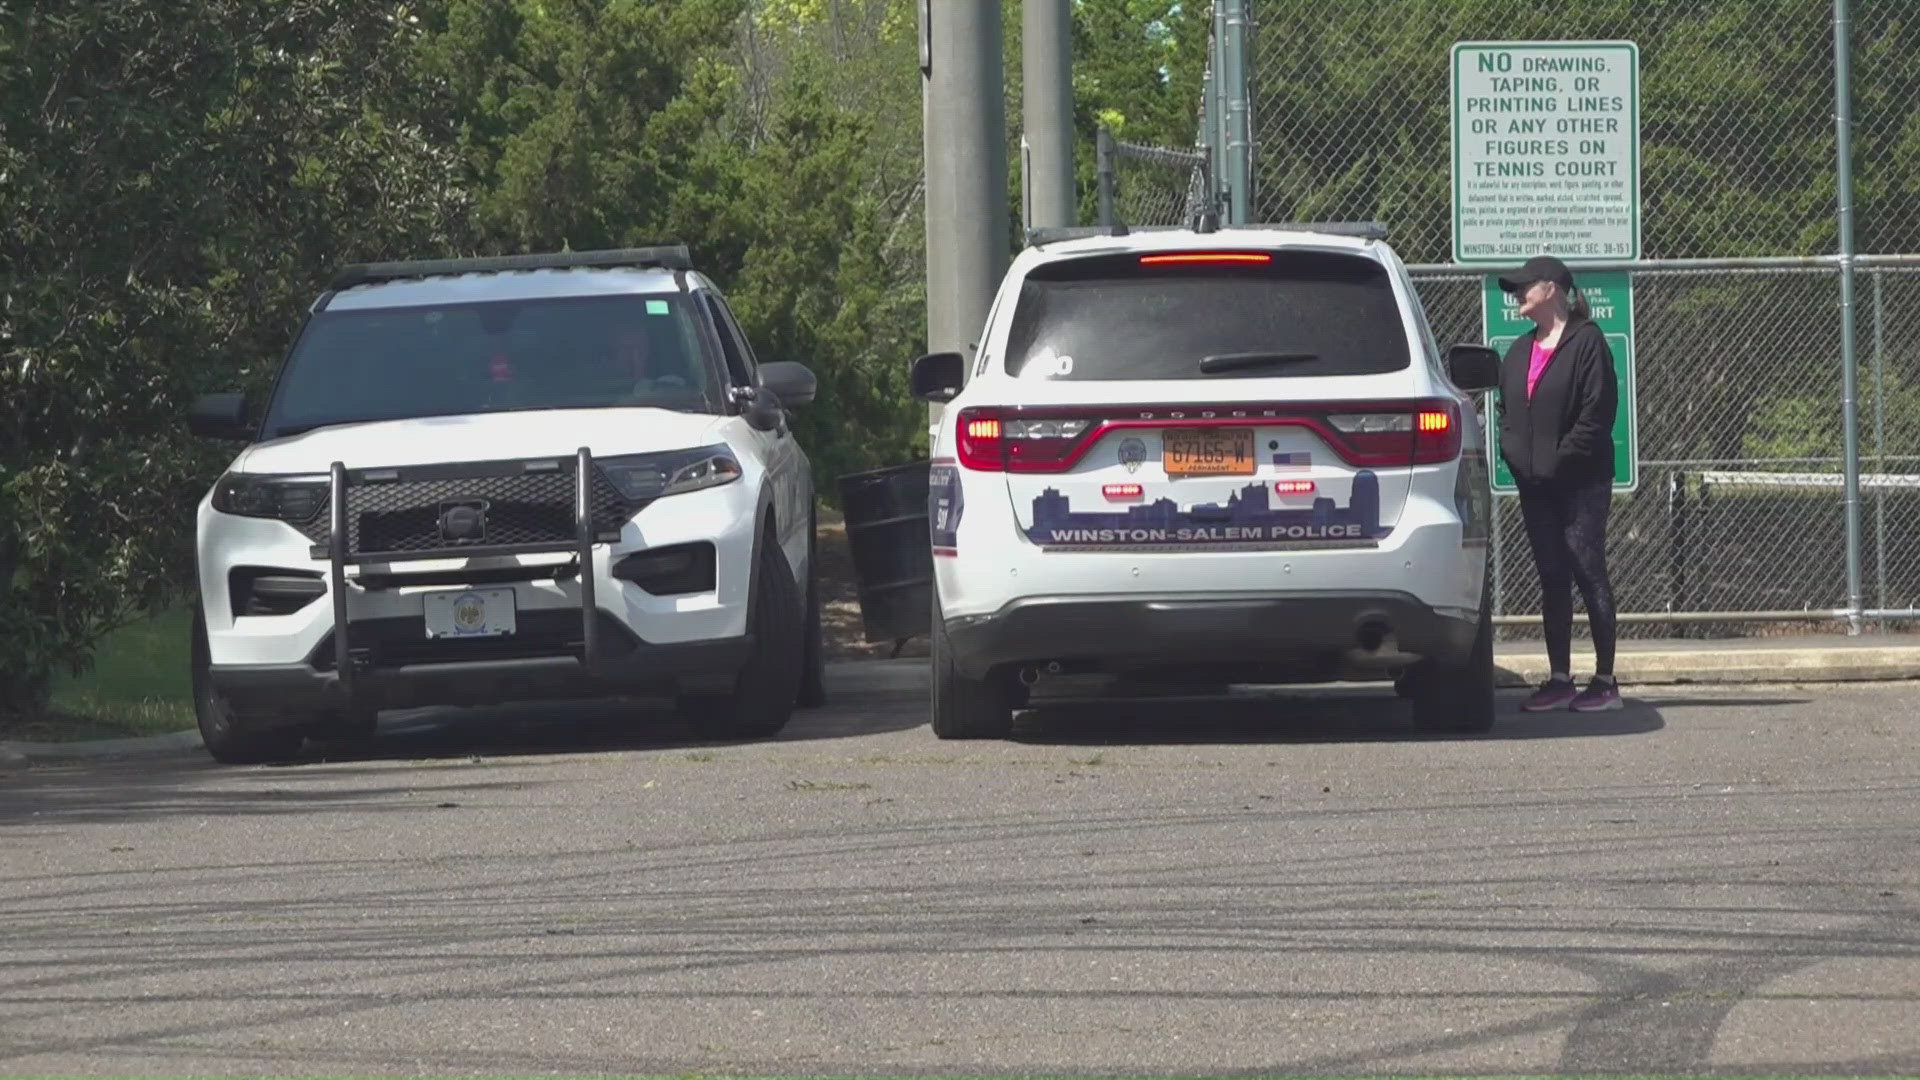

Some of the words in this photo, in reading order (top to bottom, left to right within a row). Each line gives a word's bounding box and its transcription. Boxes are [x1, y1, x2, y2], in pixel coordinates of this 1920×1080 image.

[1478, 52, 1512, 73] NO
[1574, 76, 1600, 92] OR
[1467, 97, 1557, 112] PRINTING
[1567, 96, 1623, 112] LINES
[1471, 119, 1498, 134] OR
[1508, 118, 1547, 134] ANY
[1556, 118, 1619, 133] OTHER
[1486, 140, 1569, 155] FIGURES
[1579, 140, 1605, 155] ON
[1473, 161, 1545, 177] TENNIS
[1555, 161, 1618, 176] COURT
[1463, 243, 1522, 254] WINSTON-SALEM
[1525, 243, 1540, 254] CITY
[1543, 243, 1582, 254] ORDINANCE
[1051, 526, 1262, 542] WINSTON-SALEM
[1271, 524, 1361, 538] POLICE
